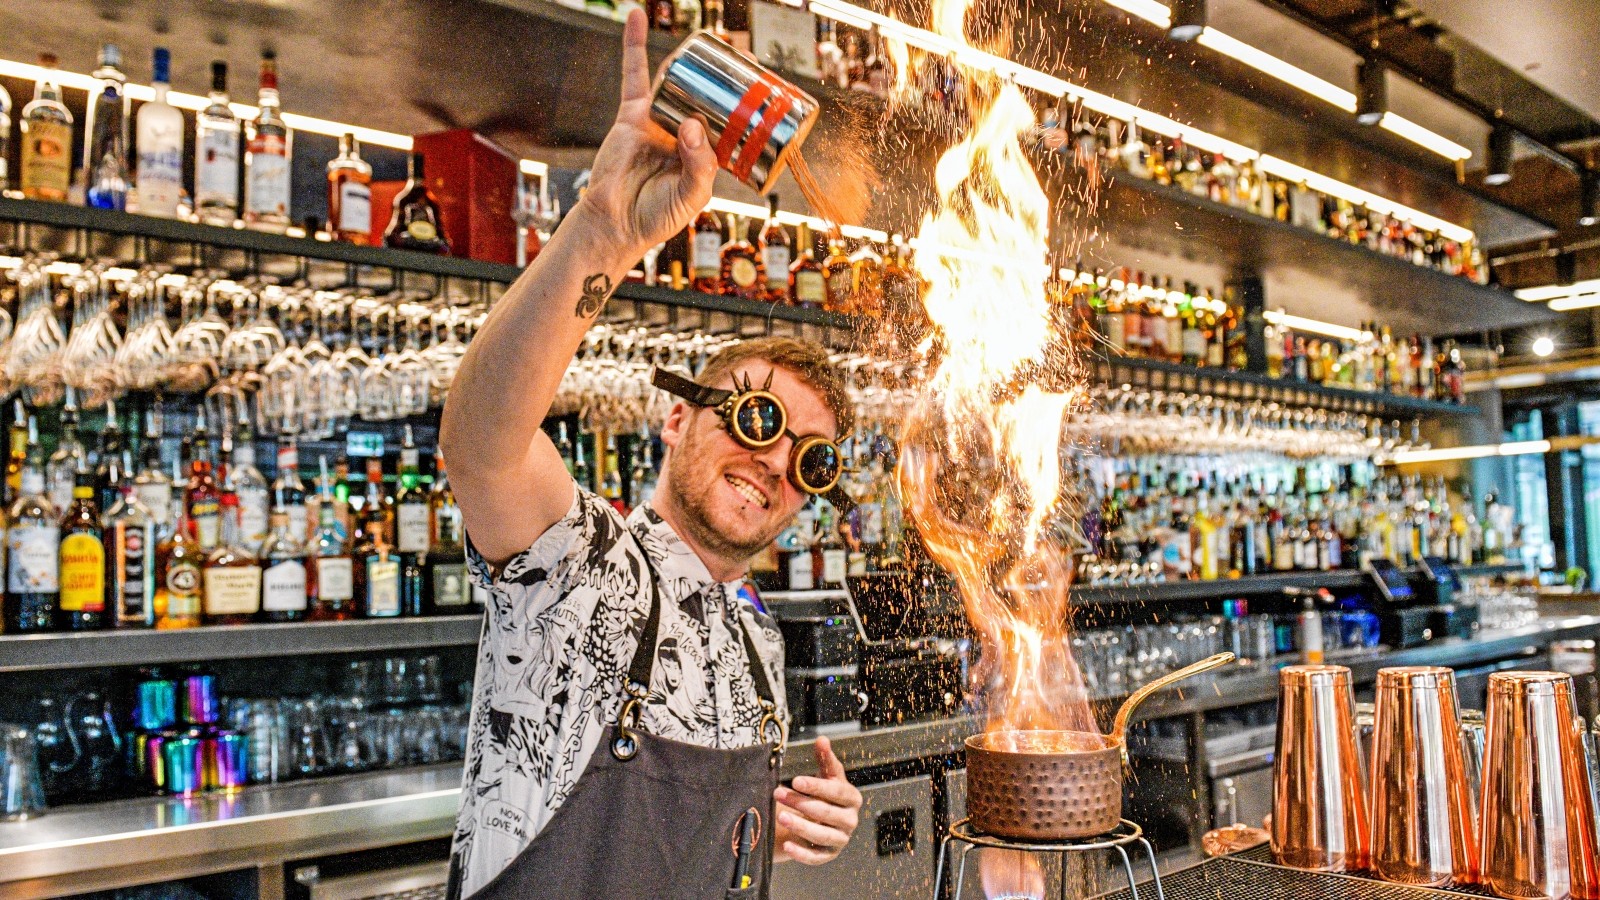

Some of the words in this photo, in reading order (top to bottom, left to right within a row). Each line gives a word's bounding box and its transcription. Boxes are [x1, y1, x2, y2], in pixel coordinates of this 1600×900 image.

[546, 606, 584, 634] EAUTIFUL
[500, 807, 522, 823] NOW
[486, 816, 511, 832] LOVE
